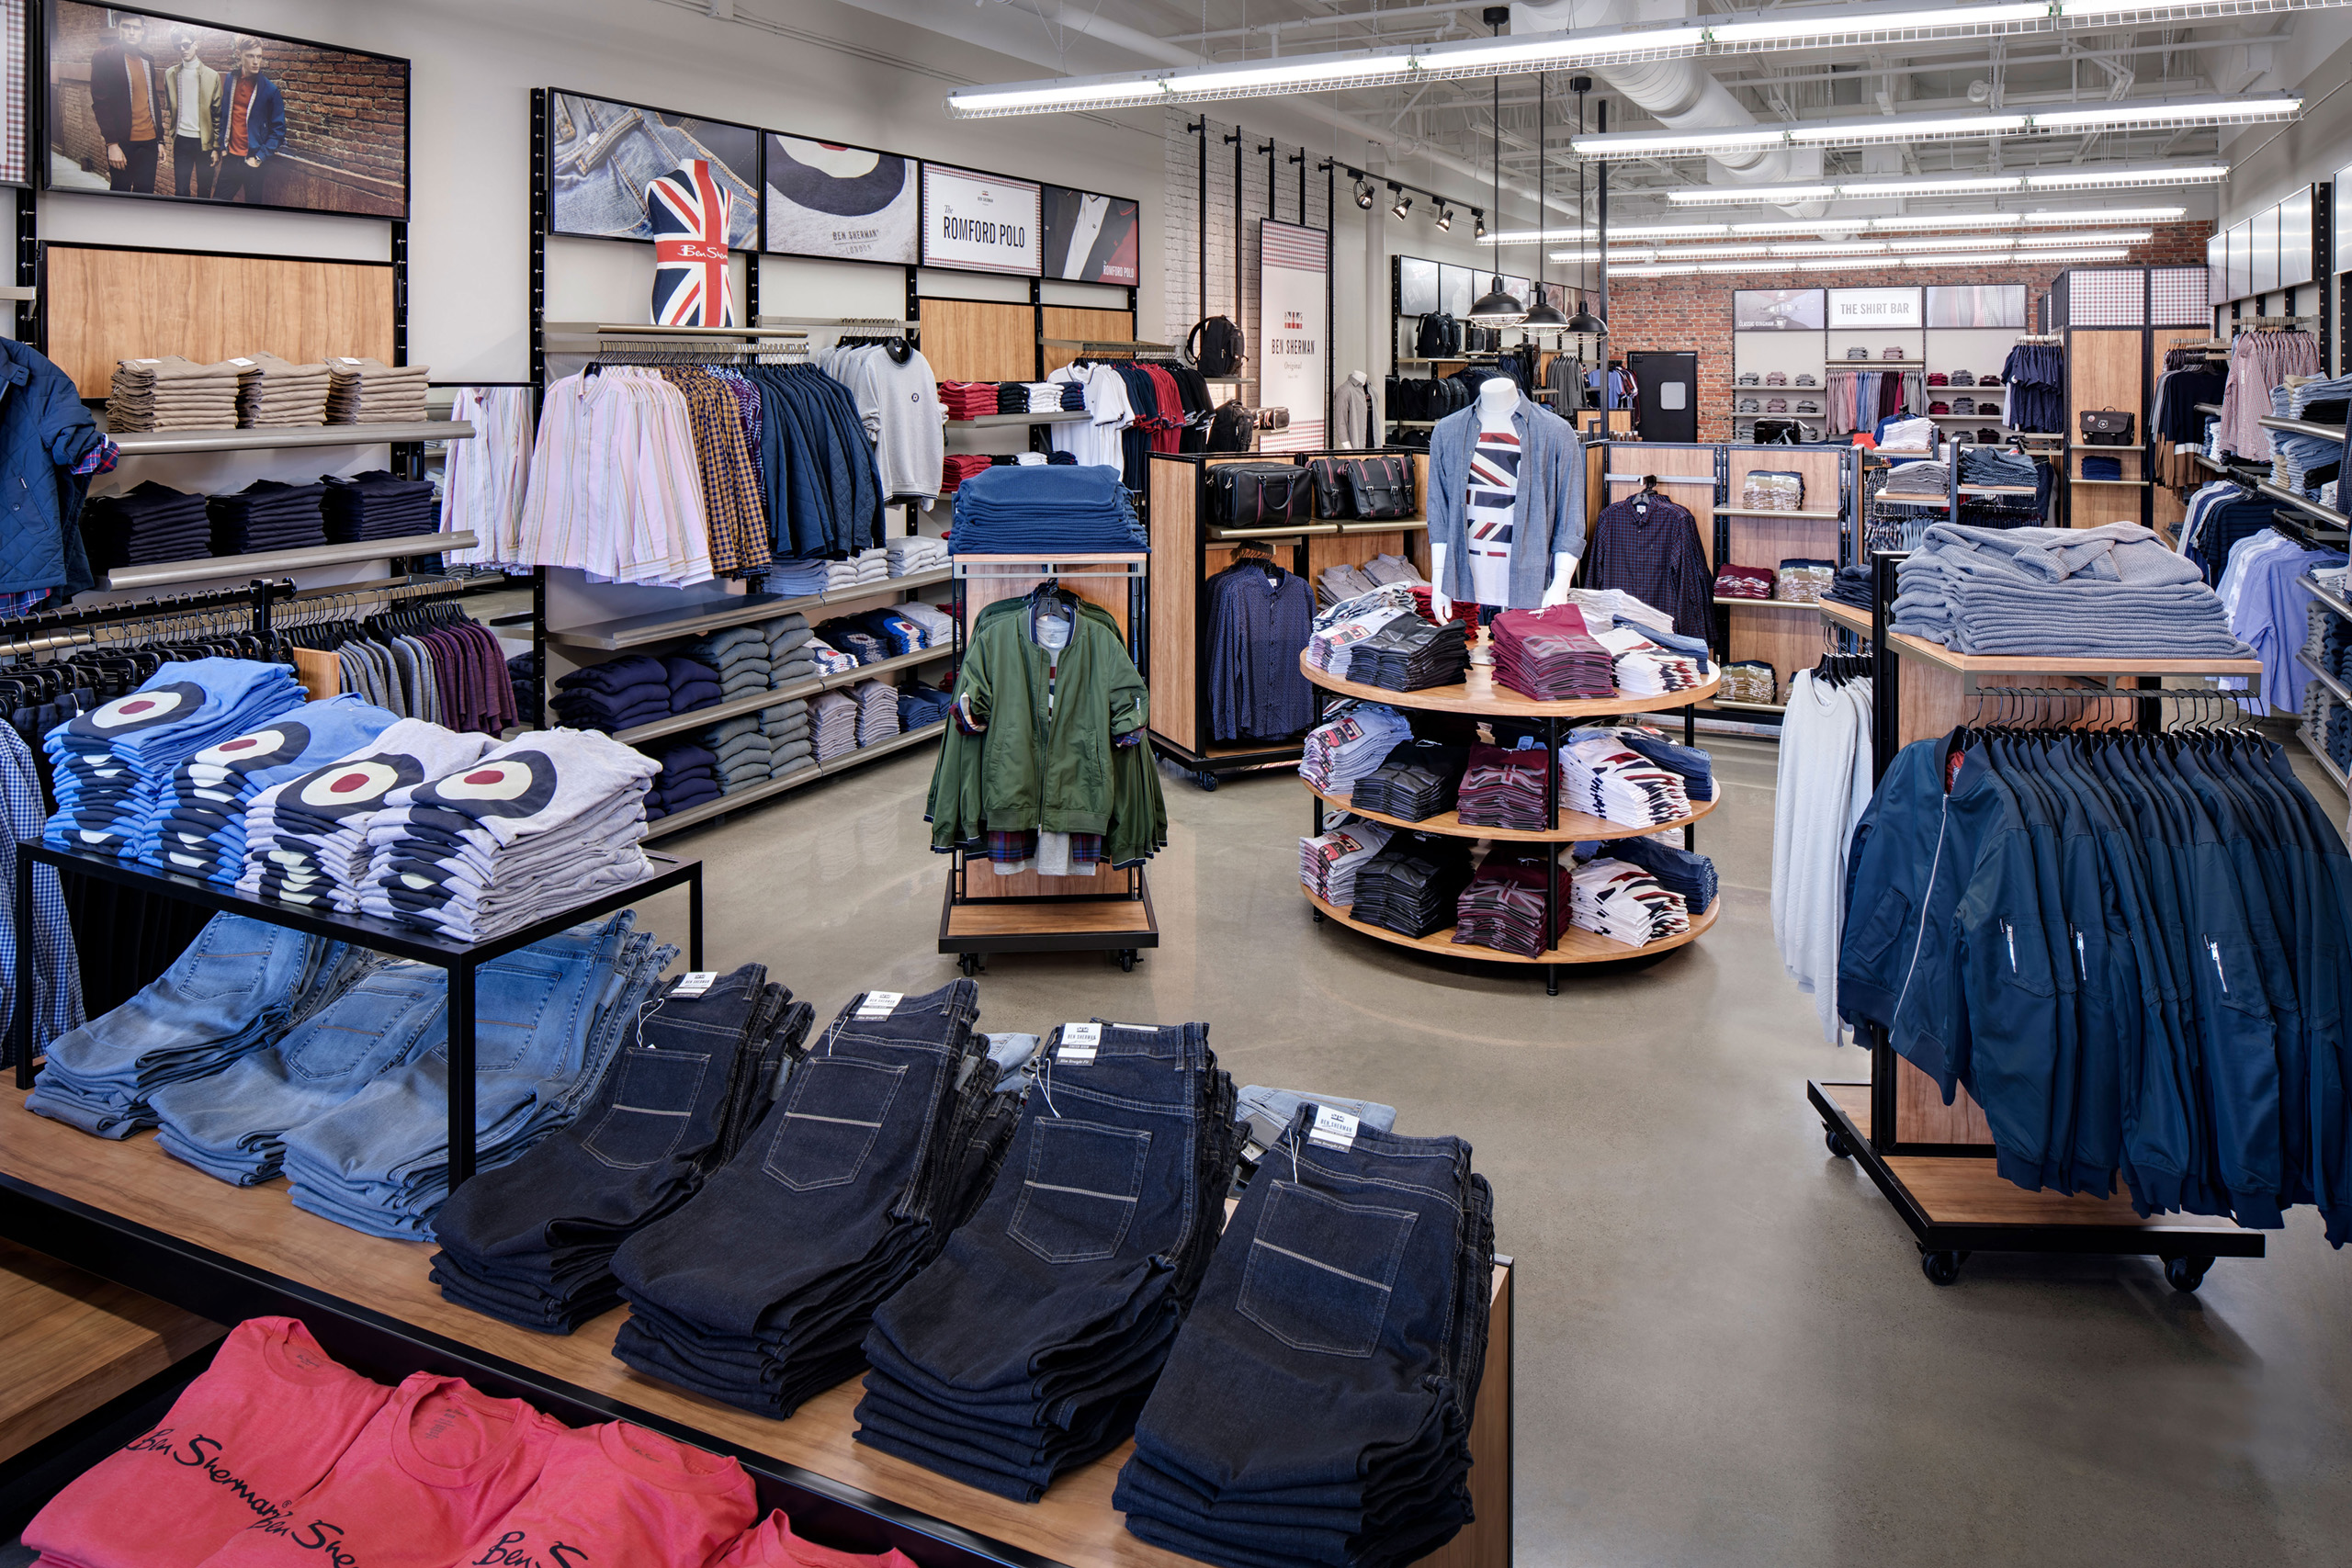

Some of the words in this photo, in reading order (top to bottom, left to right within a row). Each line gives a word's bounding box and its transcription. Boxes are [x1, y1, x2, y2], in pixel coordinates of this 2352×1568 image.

[944, 205, 954, 214] The
[832, 231, 846, 241] BEN
[944, 216, 996, 244] ROMFORD
[1000, 224, 1024, 248] POLO
[677, 244, 707, 257] Ben
[846, 244, 872, 254] LONDON
[1103, 265, 1123, 276] ROMFORD
[1124, 267, 1135, 277] POLO
[1840, 303, 1858, 315] THE
[1860, 303, 1887, 315] SHIRT
[1890, 302, 1909, 314] BAR
[1272, 339, 1283, 355] BEN
[1286, 339, 1315, 355] SHERMAN
[1284, 361, 1302, 371] Original
[1331, 1122, 1352, 1133] SHERMAN
[125, 1428, 175, 1455] Ben
[471, 1530, 533, 1568] Ben
